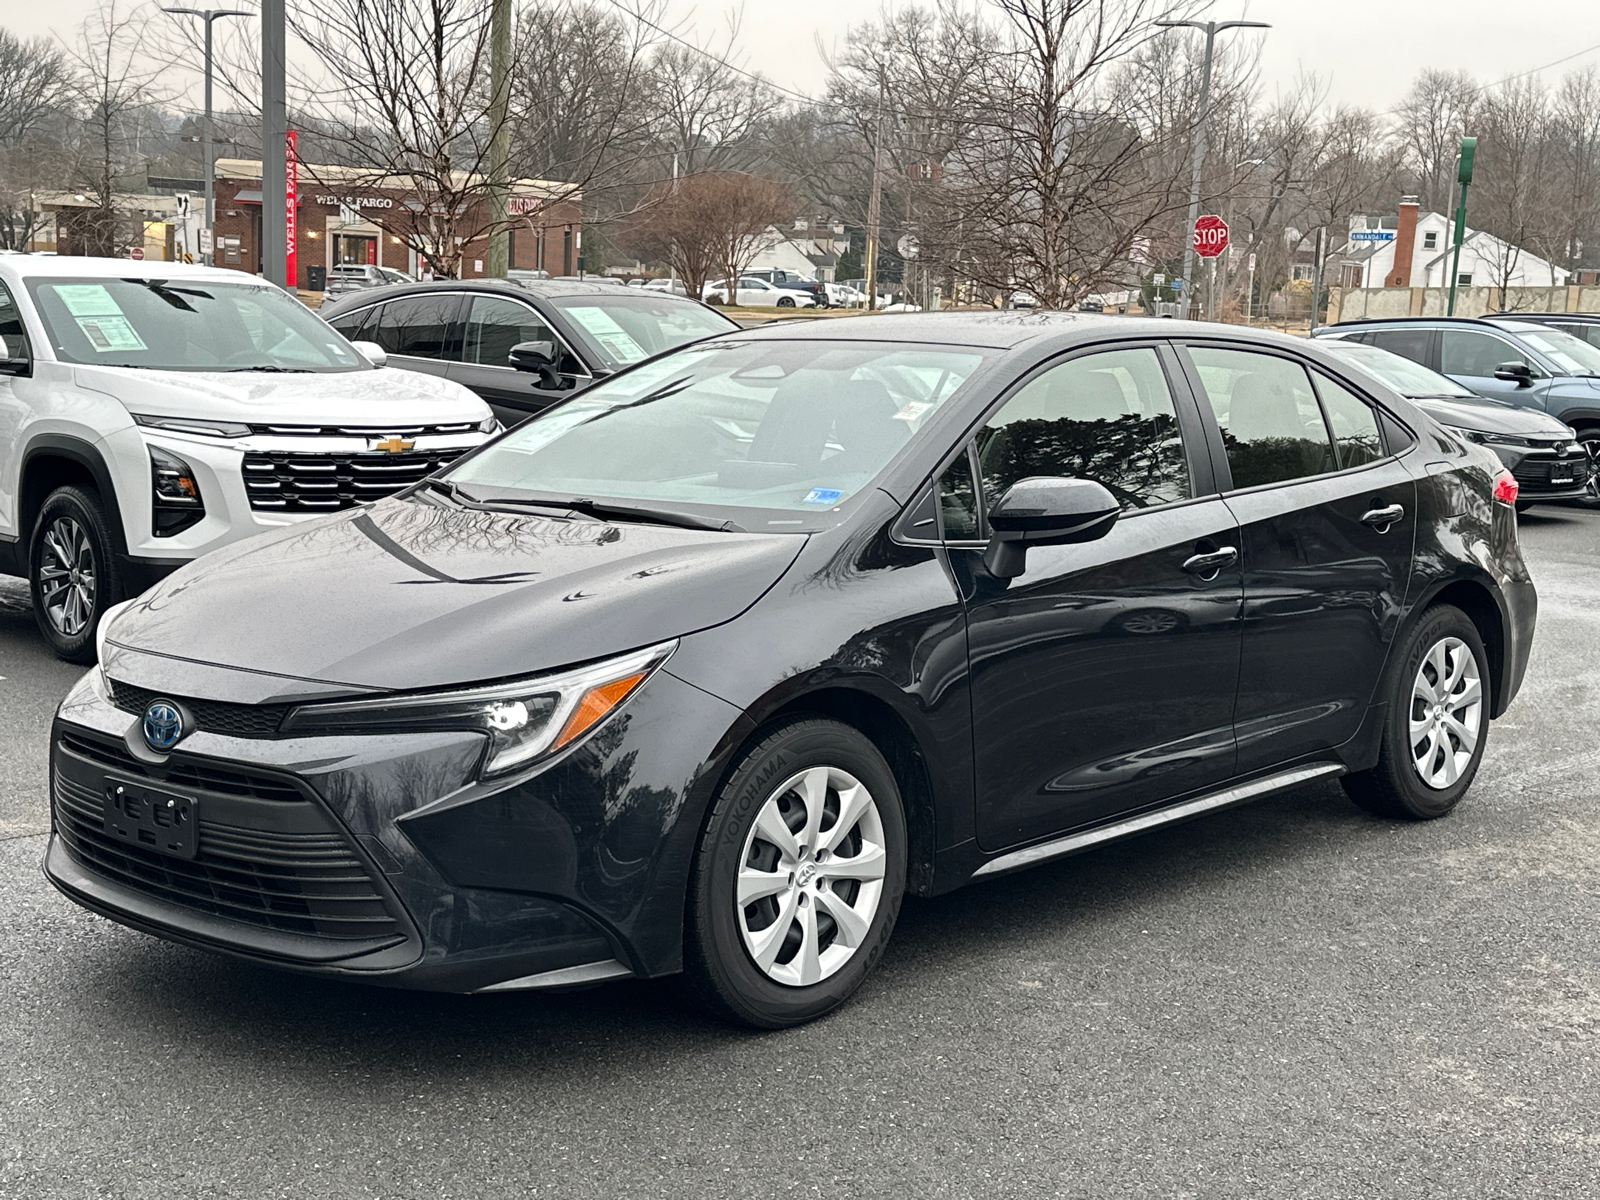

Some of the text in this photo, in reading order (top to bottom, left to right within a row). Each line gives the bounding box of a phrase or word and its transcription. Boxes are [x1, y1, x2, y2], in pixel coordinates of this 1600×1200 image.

[356, 197, 393, 209] FARGO
[286, 198, 295, 256] WELLS
[1193, 228, 1227, 245] STOP
[1409, 632, 1430, 677] AVID
[722, 754, 788, 845] YOKOHAMA
